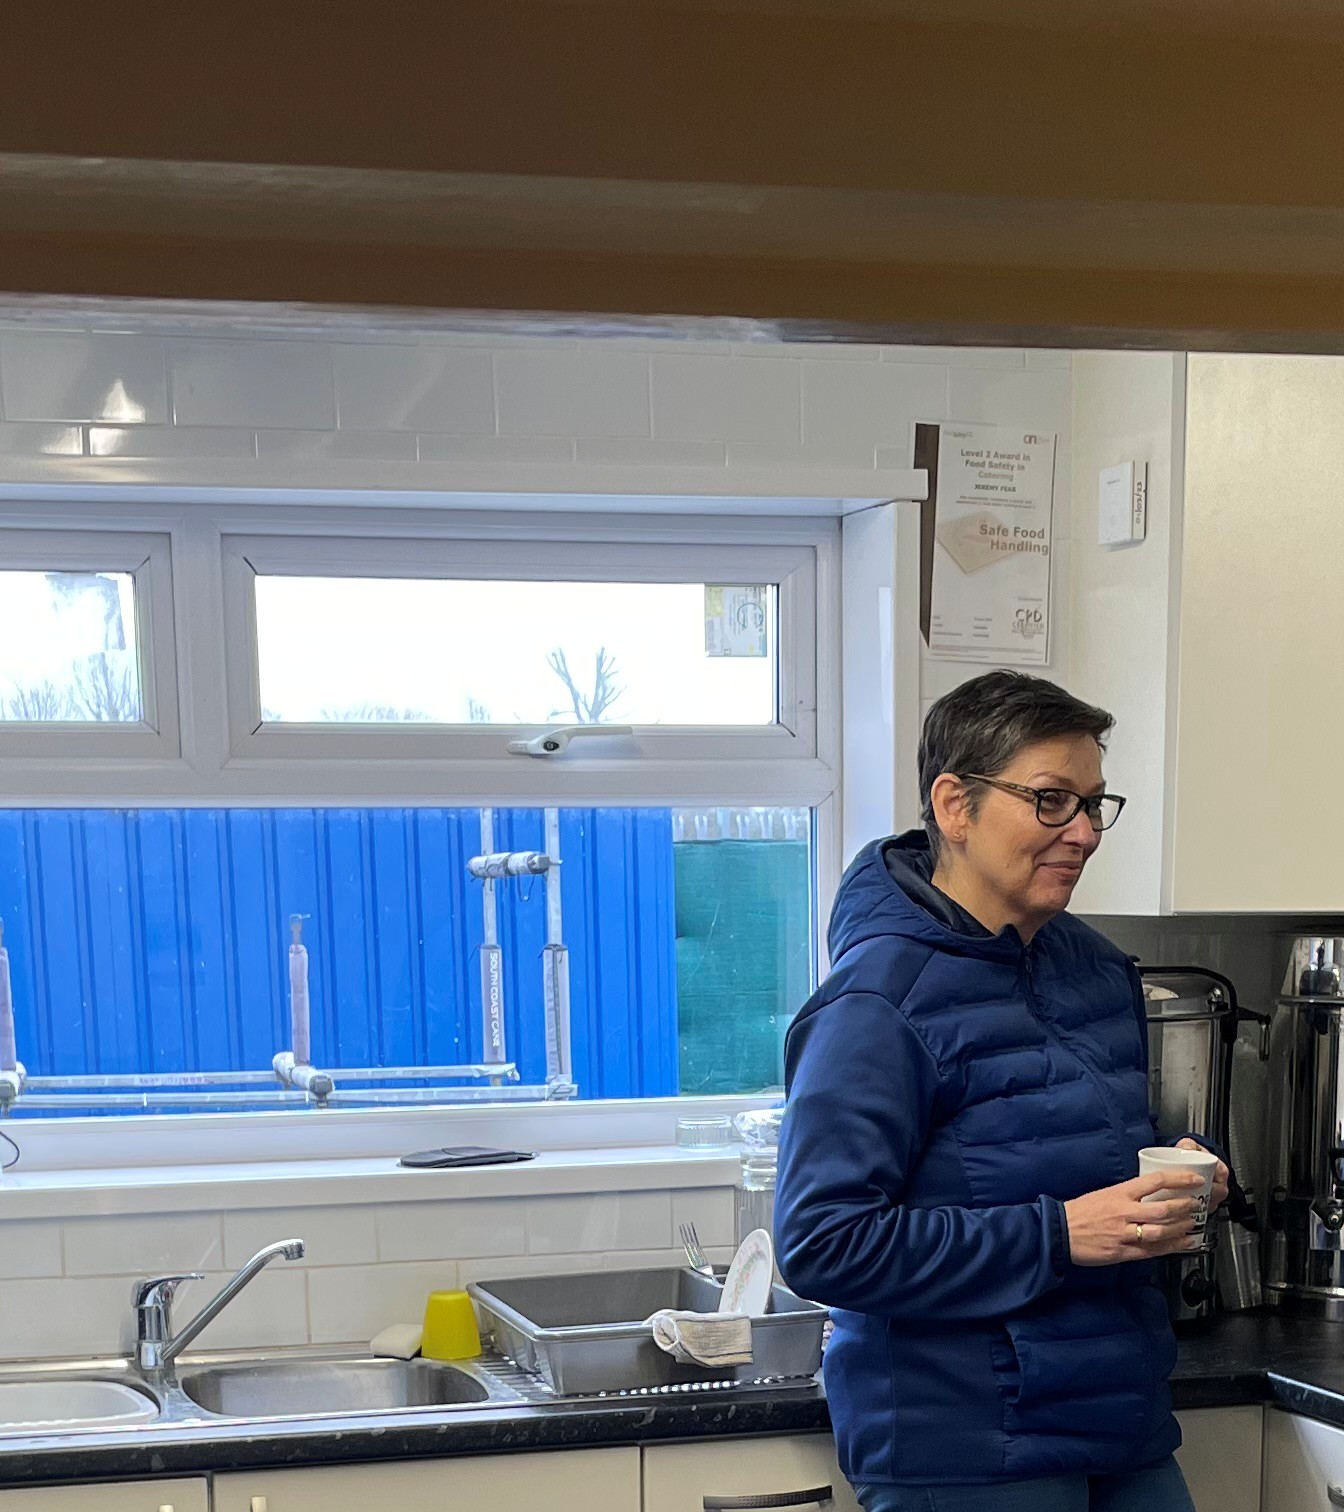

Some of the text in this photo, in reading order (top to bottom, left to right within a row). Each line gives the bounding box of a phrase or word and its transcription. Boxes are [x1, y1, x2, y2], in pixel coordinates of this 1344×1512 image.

[960, 448, 983, 458] Level
[993, 451, 1021, 461] Award
[965, 460, 986, 468] Food
[988, 461, 1015, 471] Safety
[978, 471, 1014, 481] Catering
[979, 524, 1045, 539] Safe Food
[990, 539, 1049, 556] Handling
[489, 952, 499, 985] SOUTH
[490, 986, 499, 1019] COAST
